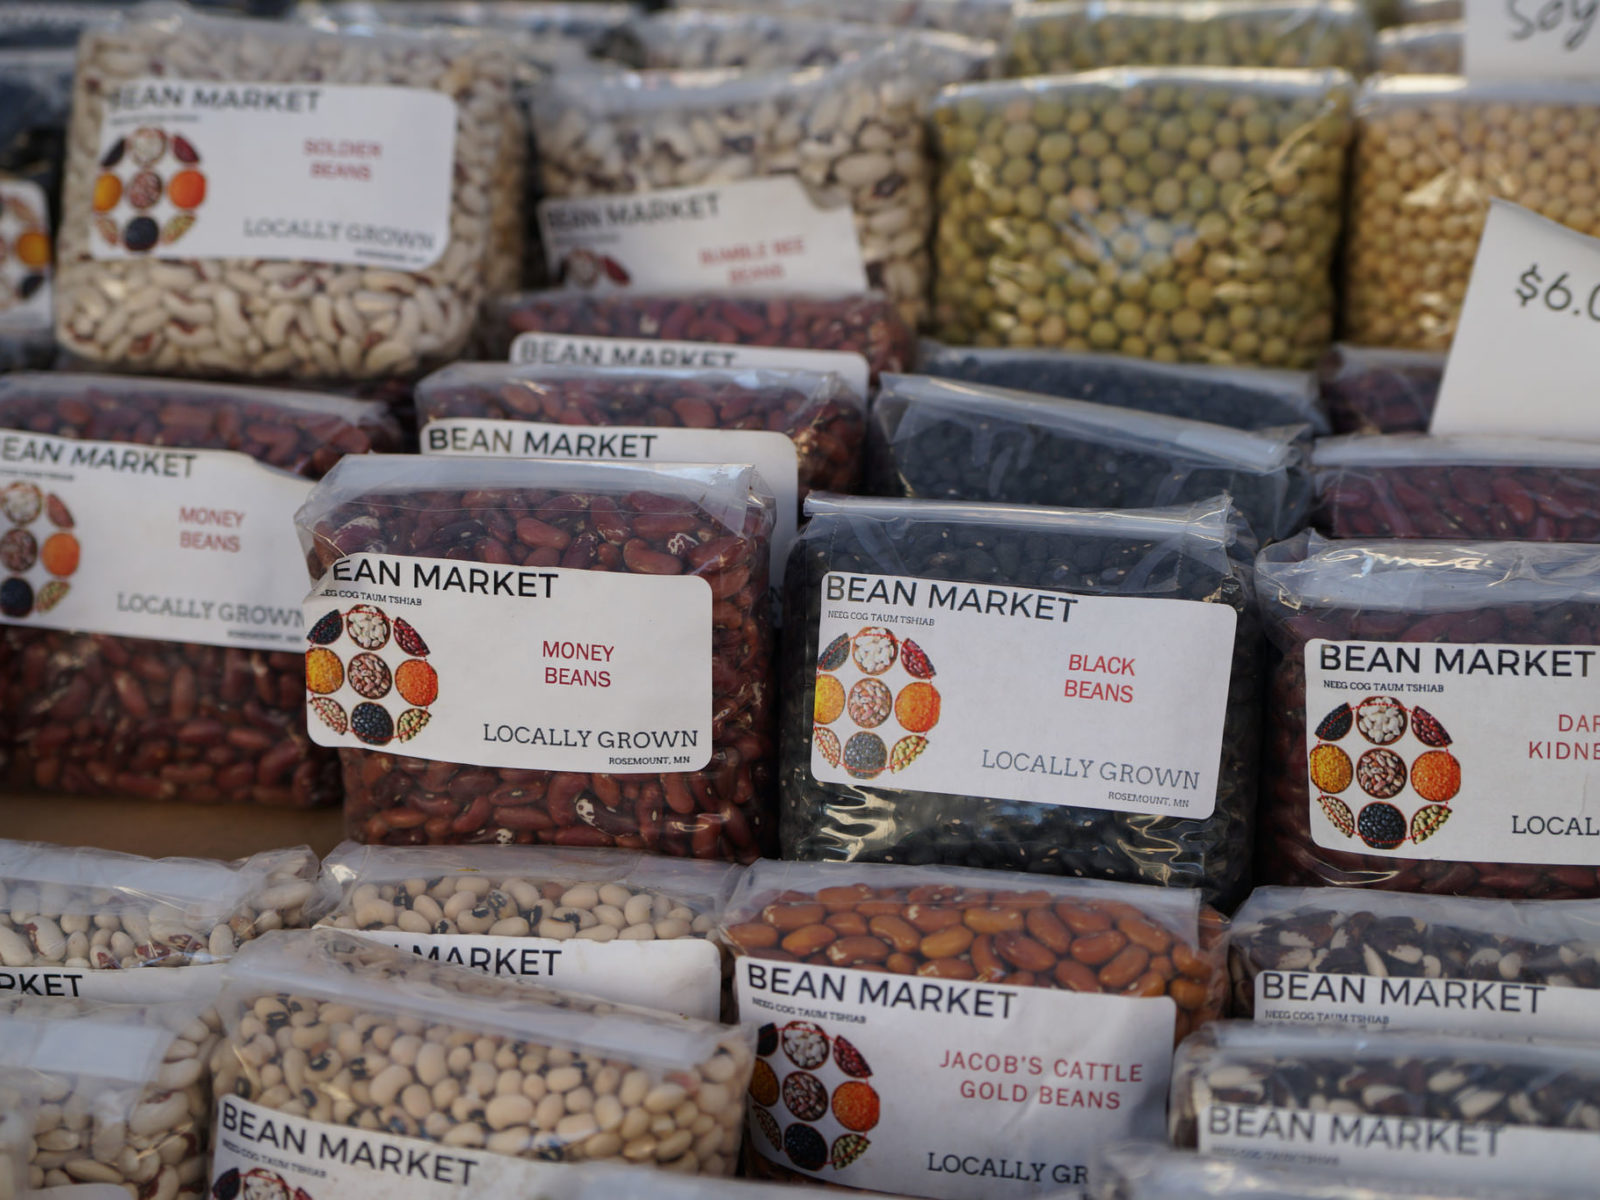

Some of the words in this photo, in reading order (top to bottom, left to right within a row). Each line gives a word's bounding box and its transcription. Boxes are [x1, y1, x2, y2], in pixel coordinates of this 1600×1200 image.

[192, 87, 321, 112] MARKET
[311, 162, 371, 181] BEANS
[606, 194, 720, 226] MARKET
[244, 219, 340, 241] LOCALLY
[346, 223, 435, 249] GROWN
[521, 339, 602, 364] BEAN
[613, 347, 737, 367] MARKET
[2, 436, 65, 465] EAN
[71, 446, 198, 478] MARKET
[429, 427, 512, 453] BEAN
[524, 431, 657, 458] MARKET
[179, 507, 245, 528] MONEY
[180, 531, 241, 553] BEANS
[333, 558, 400, 587] EAN
[413, 563, 559, 598] MARKET
[117, 592, 214, 620] LOCALLY
[218, 603, 305, 628] GROWN
[339, 590, 359, 599] COG
[360, 592, 387, 604] TAUM
[388, 595, 423, 606] TSHIAB
[826, 574, 918, 607] BEAN
[928, 583, 1079, 623] MARKET
[827, 610, 849, 620] NEEG
[850, 611, 868, 621] COG
[870, 613, 898, 624] TAUM
[899, 615, 936, 627] TSHIAB
[542, 640, 615, 662] MONEY
[1068, 654, 1136, 676] BLACK
[1320, 643, 1420, 674] BEAN
[1435, 647, 1596, 678] MARKET
[545, 667, 611, 687] BEANS
[1064, 679, 1134, 704] BEANS
[1323, 680, 1349, 690] NEEG
[1350, 681, 1371, 691] COG
[1373, 682, 1404, 693] TAUM
[1406, 683, 1444, 693] TSHIAB
[483, 723, 592, 748] LOCALLY
[598, 730, 698, 749] GROWN
[608, 756, 672, 766] ROSEMOUNT,
[673, 756, 691, 765] MN
[982, 749, 1094, 779] LOCALLY
[1099, 762, 1200, 791] GROWN
[1173, 798, 1190, 809] MN
[747, 963, 845, 1002] BEAN
[858, 977, 1018, 1019] MARKET
[1263, 972, 1365, 1004] BEAN
[1380, 979, 1546, 1014] MARKET
[775, 1003, 796, 1015] COG
[940, 1050, 1043, 1075] JACOB'S
[1054, 1058, 1143, 1083] CATTLE
[960, 1080, 1028, 1102] GOLD
[1039, 1085, 1120, 1110] BEANS
[222, 1101, 307, 1155] BEAN
[319, 1133, 479, 1186] MARKET
[1209, 1106, 1315, 1142] BEAN
[1330, 1114, 1505, 1157] MARKET
[927, 1152, 1046, 1183] LOCALLY
